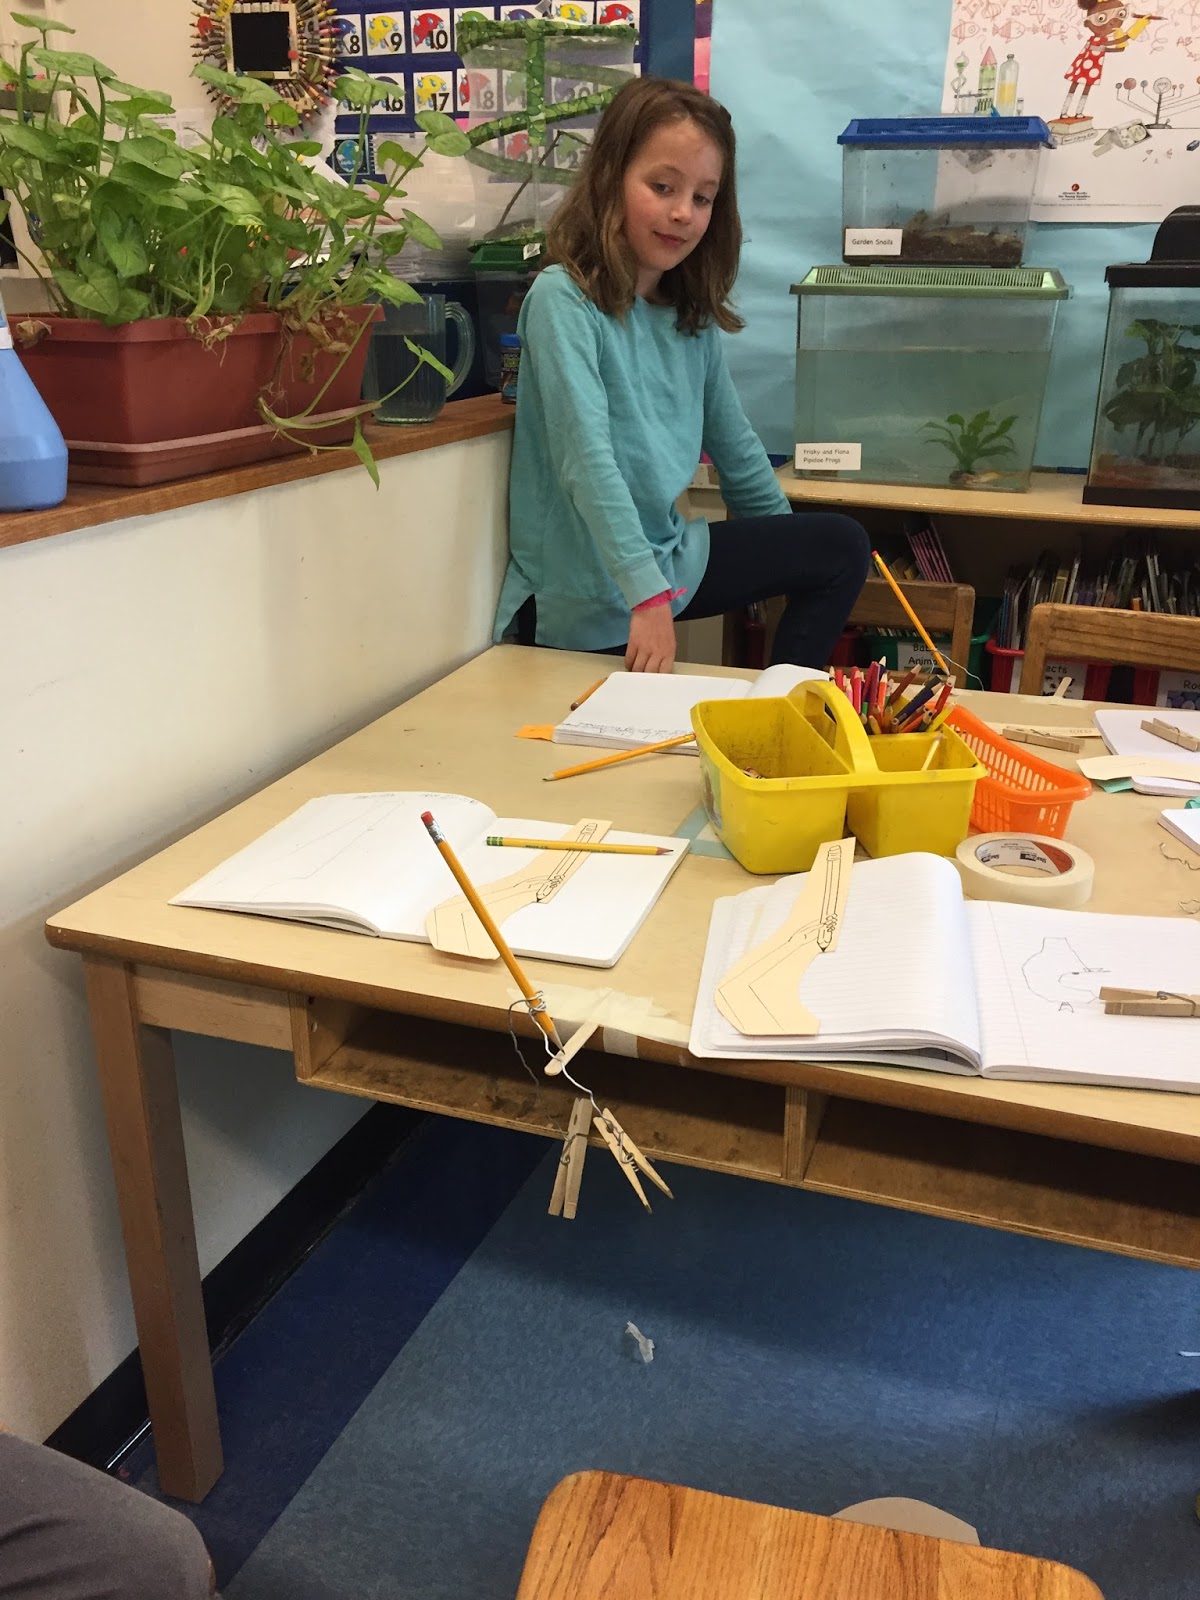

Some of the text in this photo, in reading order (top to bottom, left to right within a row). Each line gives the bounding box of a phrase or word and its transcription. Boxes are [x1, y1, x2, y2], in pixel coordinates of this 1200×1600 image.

[349, 34, 361, 54] 8
[390, 32, 402, 52] 9
[428, 30, 449, 50] 10
[430, 92, 450, 112] 17
[851, 238, 893, 246] Garden Snails
[825, 457, 841, 465] Frogs
